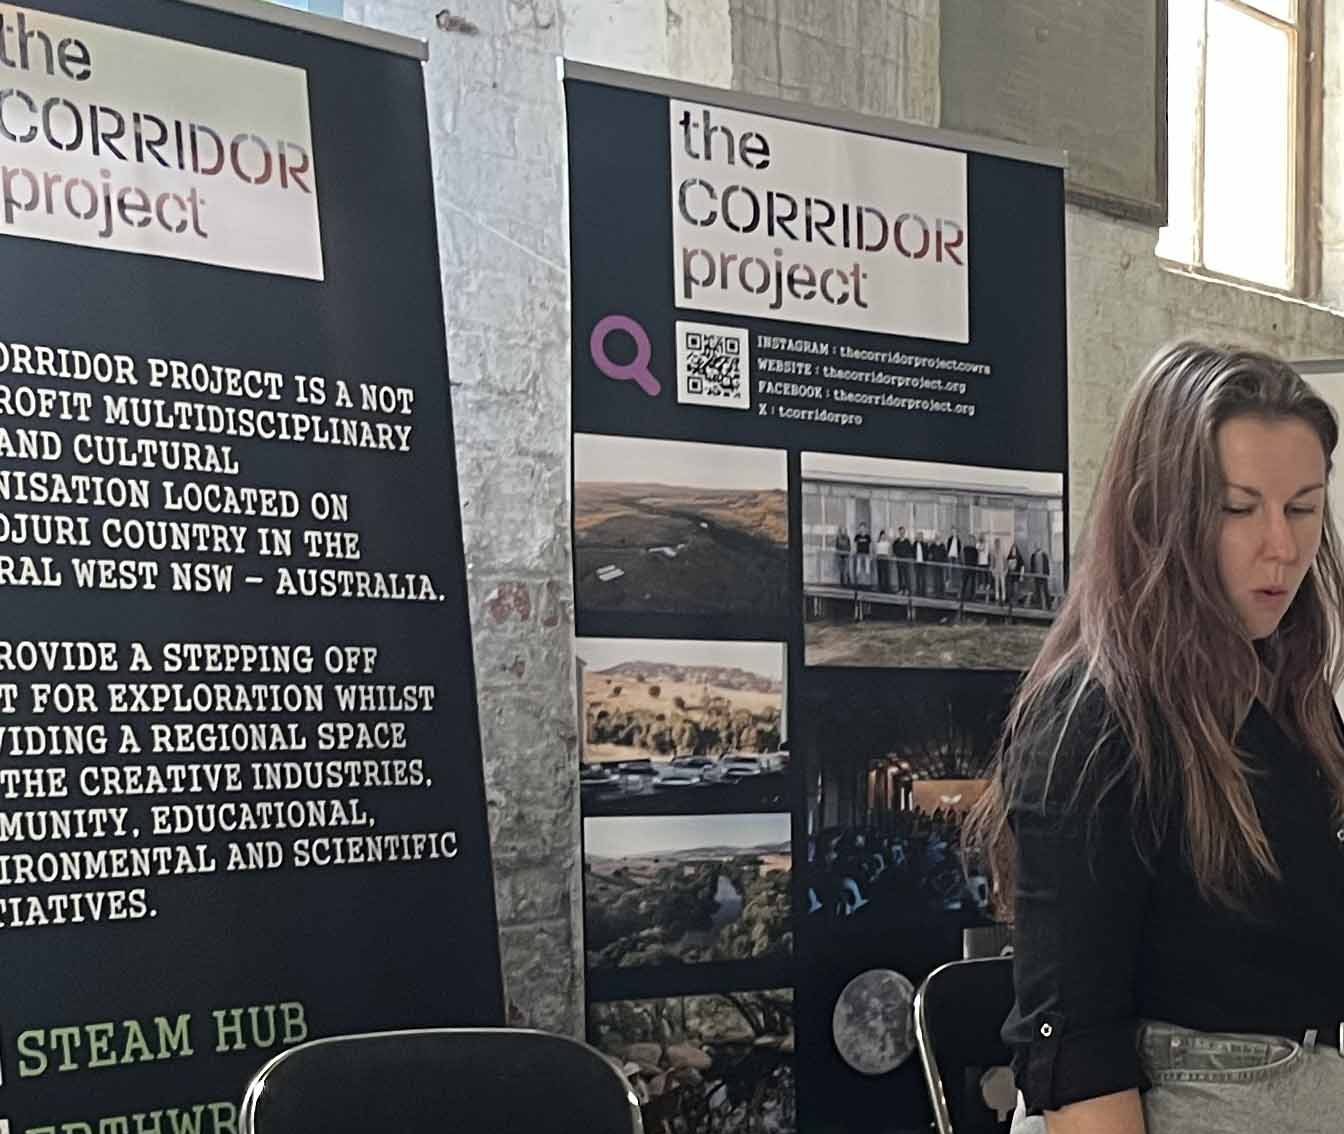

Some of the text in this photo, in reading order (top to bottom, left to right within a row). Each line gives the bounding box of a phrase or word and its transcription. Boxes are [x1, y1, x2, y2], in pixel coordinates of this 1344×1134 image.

[0, 12, 92, 81] the
[0, 88, 313, 194] CORRIDOR
[680, 110, 771, 170] the
[2, 165, 209, 239] project
[678, 177, 965, 267] CORRIDOR
[682, 246, 869, 311] project
[757, 335, 829, 356] INSTAGRAM
[148, 359, 283, 400] PROJECT
[295, 376, 325, 404] IS
[336, 381, 353, 407] A
[360, 384, 413, 414] NOT
[757, 357, 812, 377] WEBSITE
[823, 365, 967, 394] thecorridorproject.org
[758, 380, 823, 399] FACEBOOK
[833, 388, 976, 416] thecorridorproject.org
[778, 405, 863, 425] tcorridorpro
[104, 395, 411, 451] MULTIDISCIPLINARY
[0, 428, 238, 474] AND CULTURAL
[163, 481, 299, 517] LOCATED
[312, 493, 347, 521] ON
[103, 519, 247, 553] COUNTRY
[258, 528, 291, 556] IN
[304, 531, 360, 559] THE
[72, 558, 158, 589] WEST
[171, 563, 232, 592] NSW
[276, 568, 444, 601] AUSTRALIA.
[130, 643, 152, 671] A
[163, 643, 313, 673] STEPPING
[325, 646, 377, 673] OFF
[31, 684, 98, 712] FOR
[108, 684, 322, 712] EXPLORATION
[335, 685, 434, 711] WHILST
[0, 723, 406, 755] IDING A REGIONAL SPACE
[0, 768, 67, 798] THE
[80, 764, 242, 795] CREATIVE
[227, 842, 282, 870] AND
[294, 832, 457, 866] SCIENTIFIC
[17, 1001, 308, 1078] STEAM HUB
